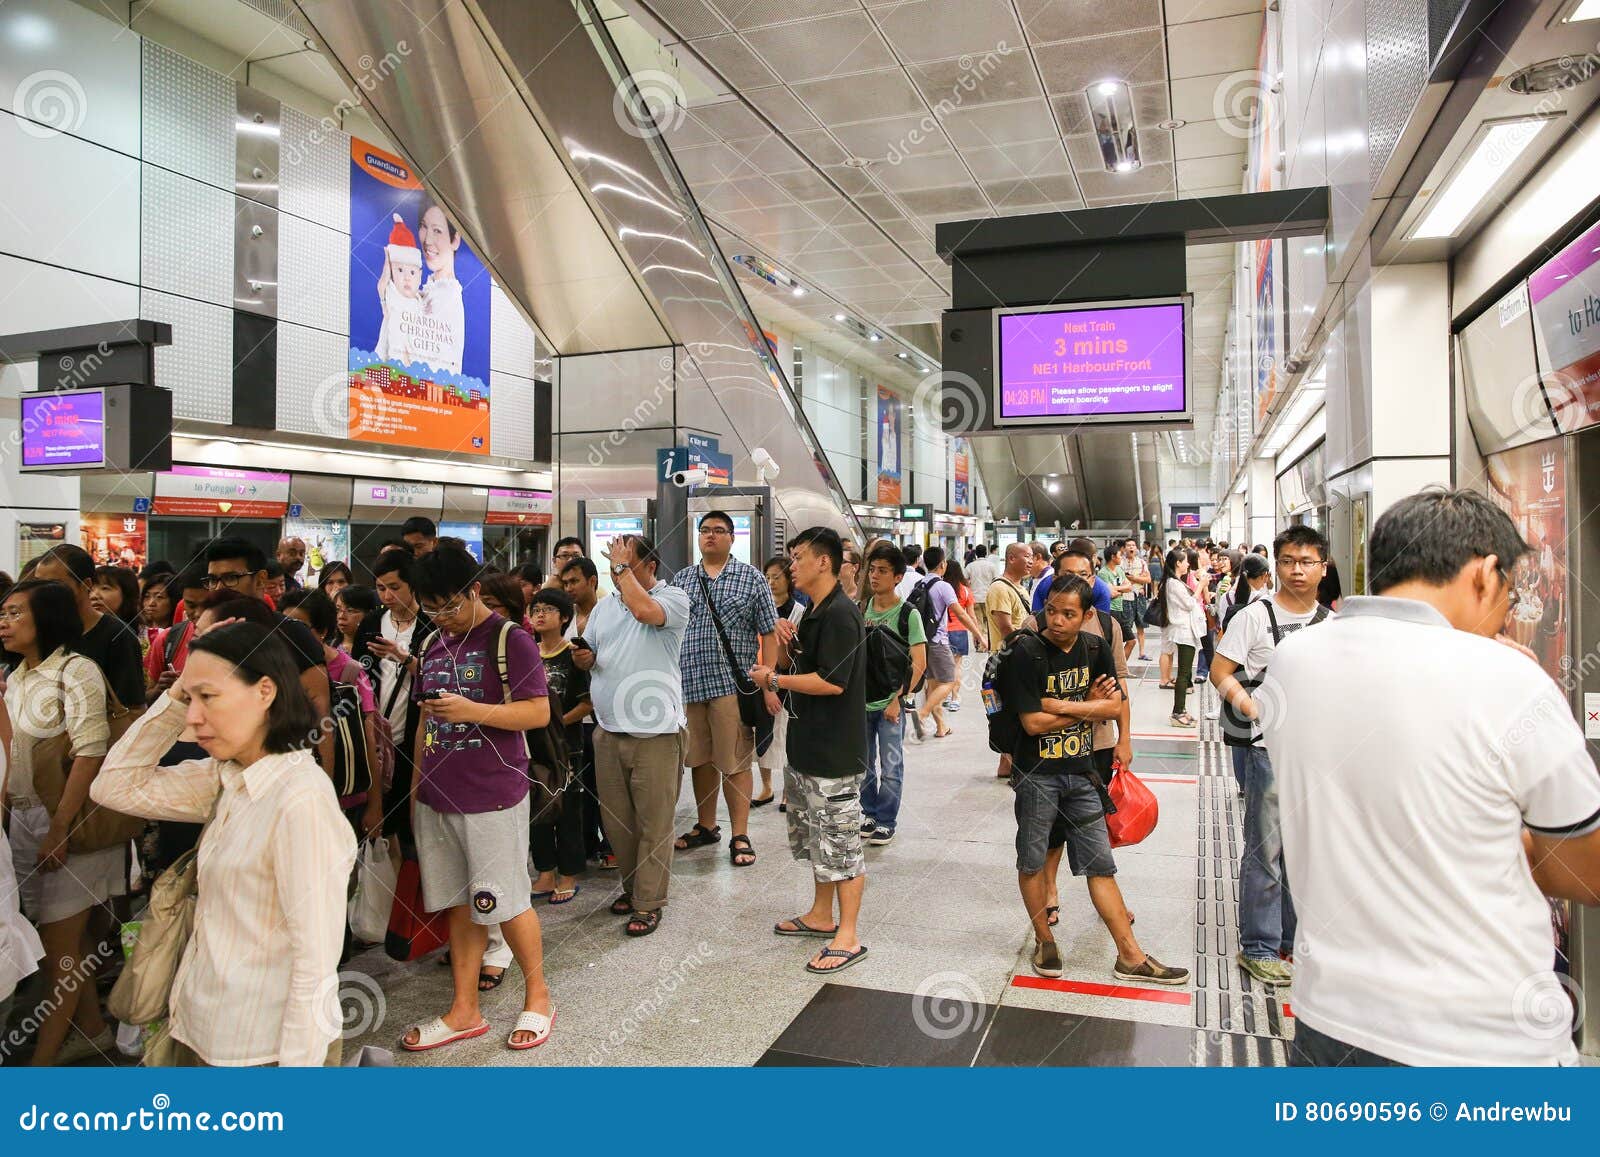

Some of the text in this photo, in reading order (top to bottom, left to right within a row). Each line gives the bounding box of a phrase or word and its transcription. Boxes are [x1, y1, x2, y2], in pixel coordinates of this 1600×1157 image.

[367, 155, 399, 174] guardian
[401, 311, 451, 332] GUARDIAN
[1064, 320, 1116, 334] Next Train
[1568, 309, 1582, 336] to
[400, 322, 453, 344] CHRISTMAS
[414, 338, 440, 353] GIFTS
[1054, 336, 1129, 357] 3 mins
[1033, 358, 1152, 375] NE1 HarbourFront
[1051, 383, 1174, 396] Please allow passengers to alight
[1051, 396, 1075, 405] before
